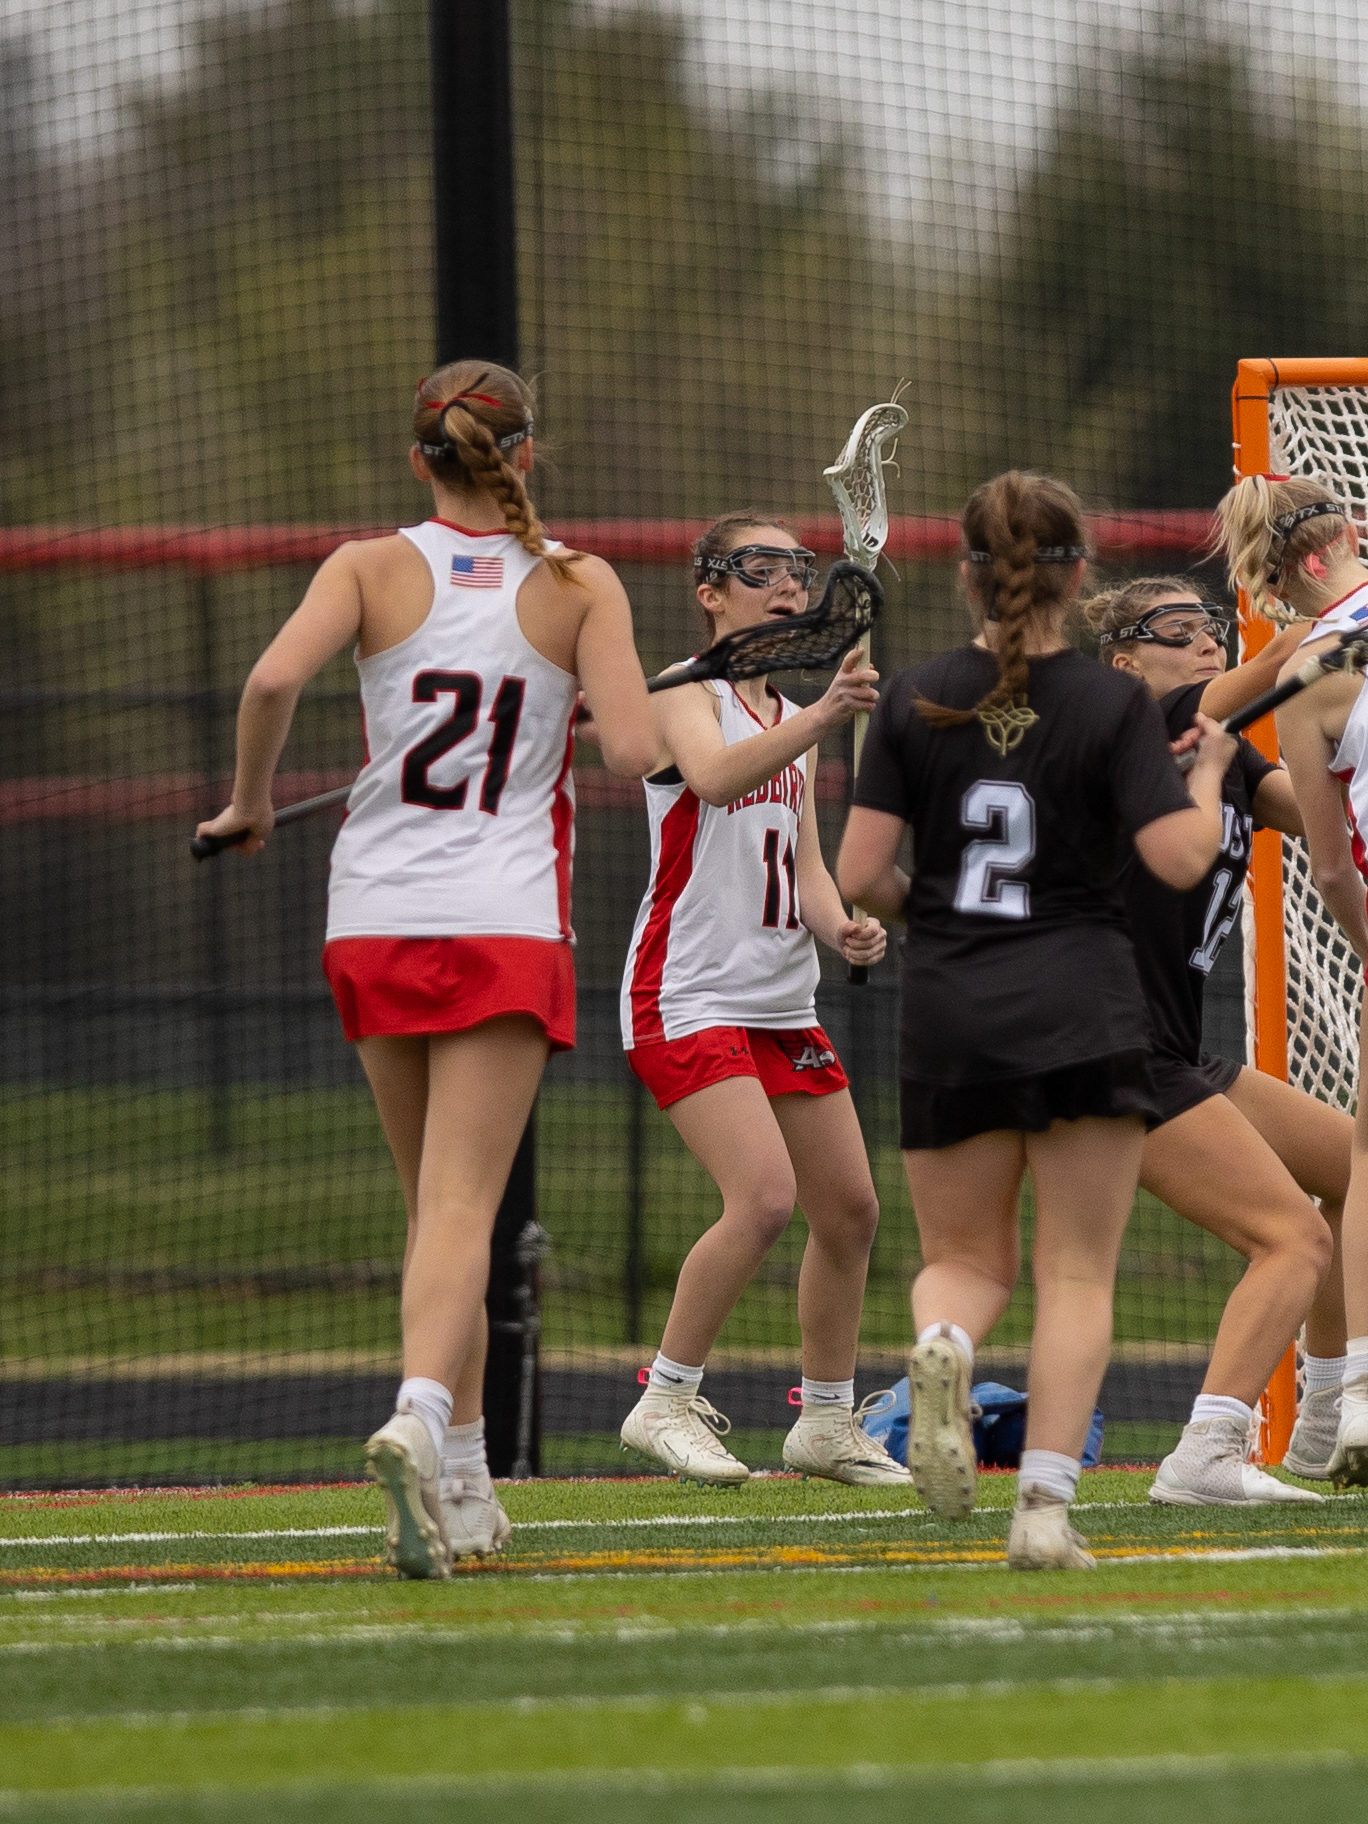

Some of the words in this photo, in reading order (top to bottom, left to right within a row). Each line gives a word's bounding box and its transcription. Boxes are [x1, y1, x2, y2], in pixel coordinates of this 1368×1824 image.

[401, 668, 526, 816] 21
[762, 828, 800, 930] 11
[953, 779, 1036, 921] 2
